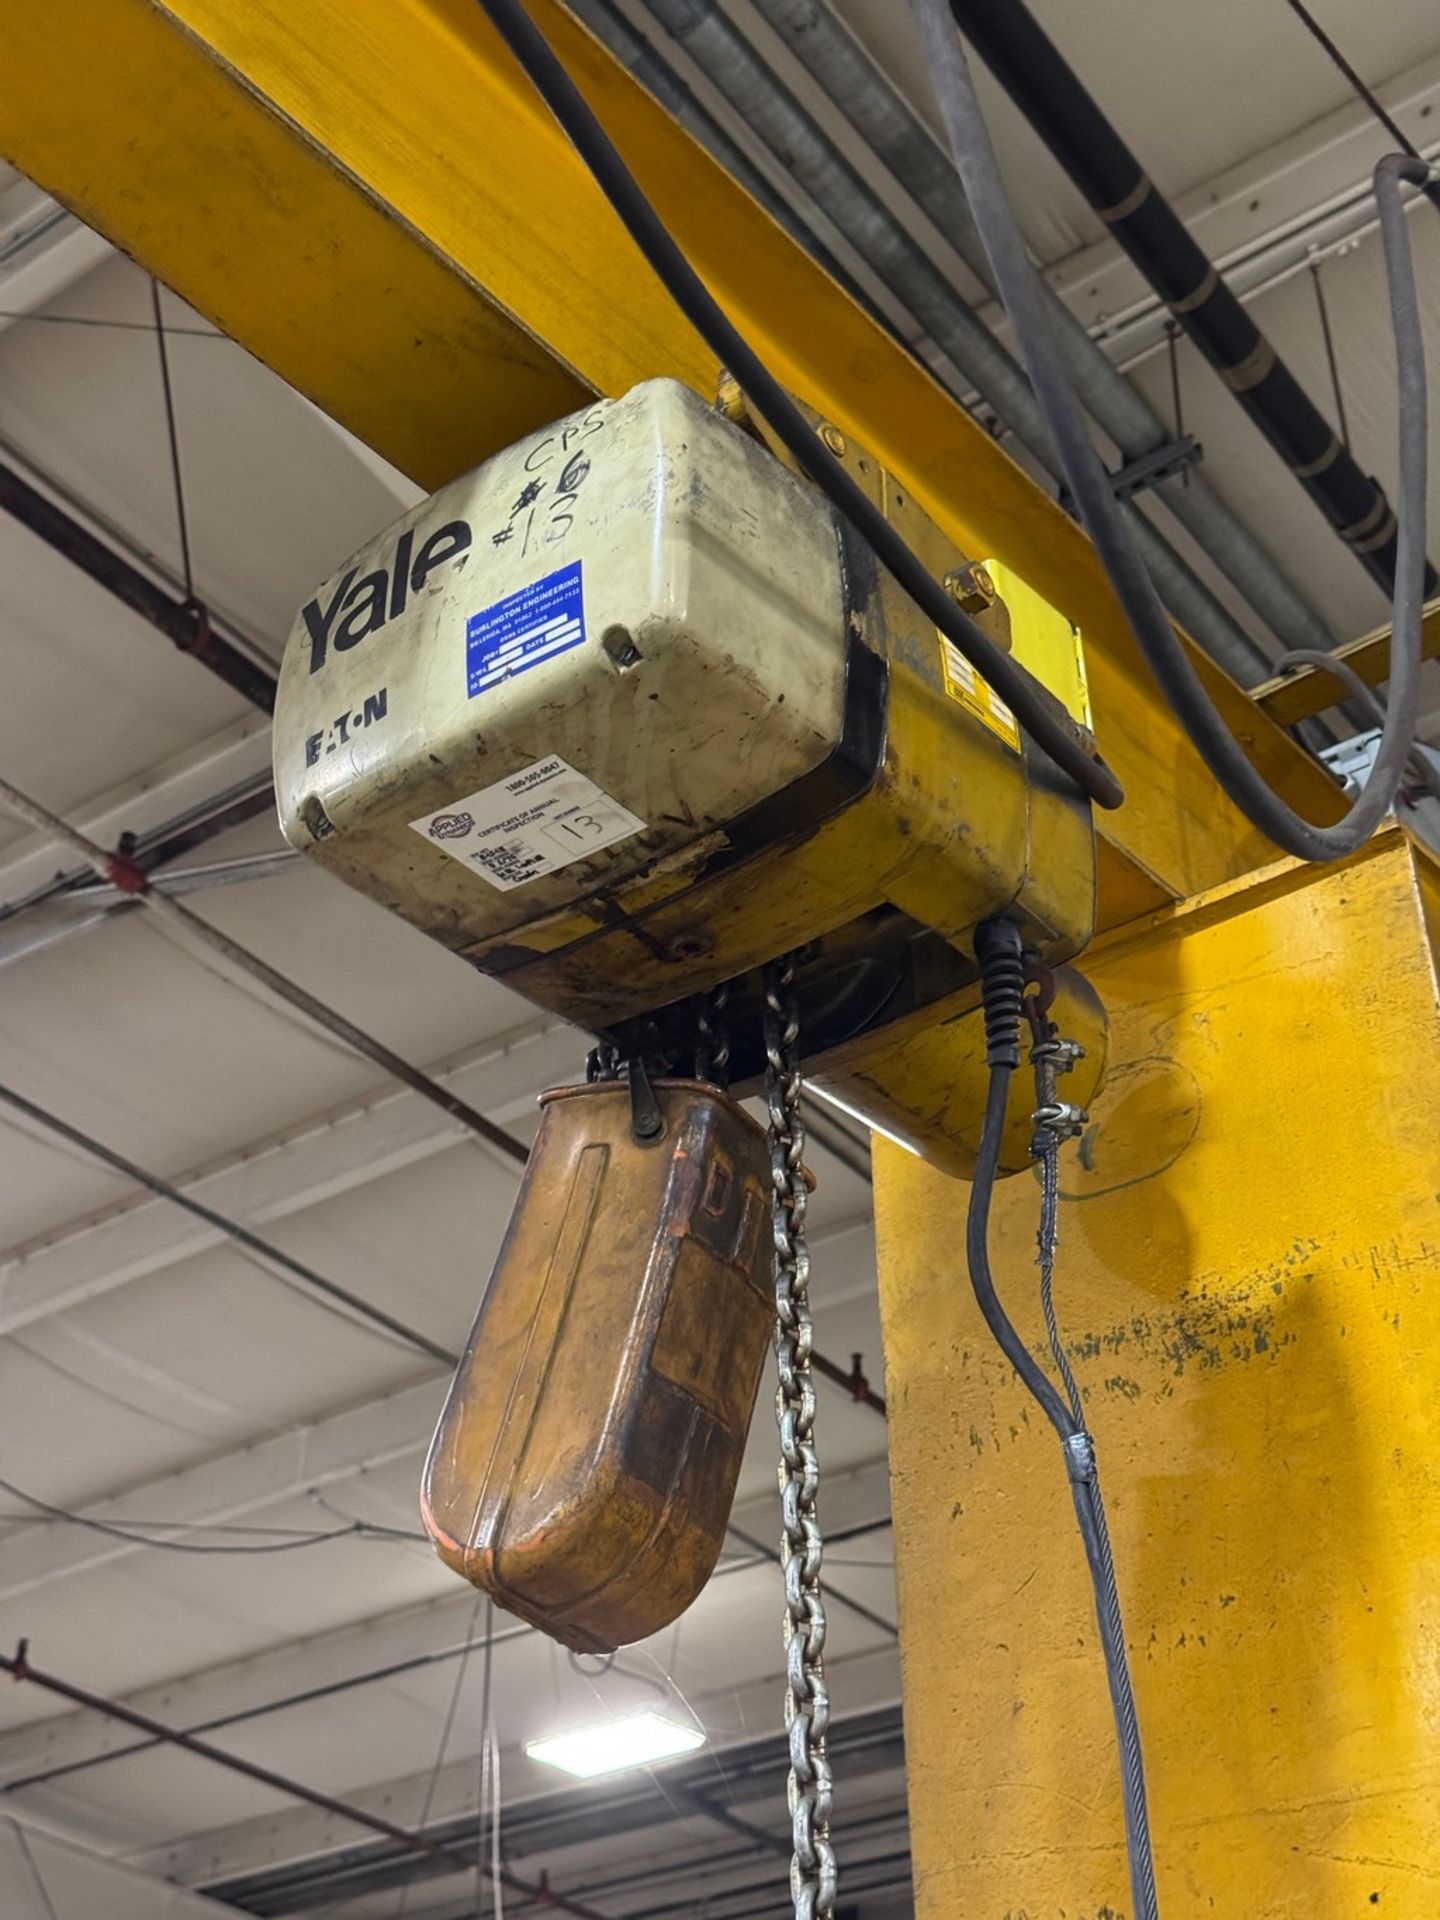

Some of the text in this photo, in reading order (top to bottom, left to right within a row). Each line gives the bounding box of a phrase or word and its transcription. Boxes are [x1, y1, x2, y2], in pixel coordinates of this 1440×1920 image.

[524, 410, 604, 472] CPS
[301, 519, 473, 675] Yale
[470, 576, 579, 638] BURLINGTON ENGINEERING
[525, 637, 544, 650] DATE
[428, 812, 472, 837] APPLIED
[477, 816, 520, 838] CERTIFICATE
[529, 798, 560, 815] ANNUAL
[503, 812, 545, 833] INSPECTION
[561, 815, 603, 840] 13
